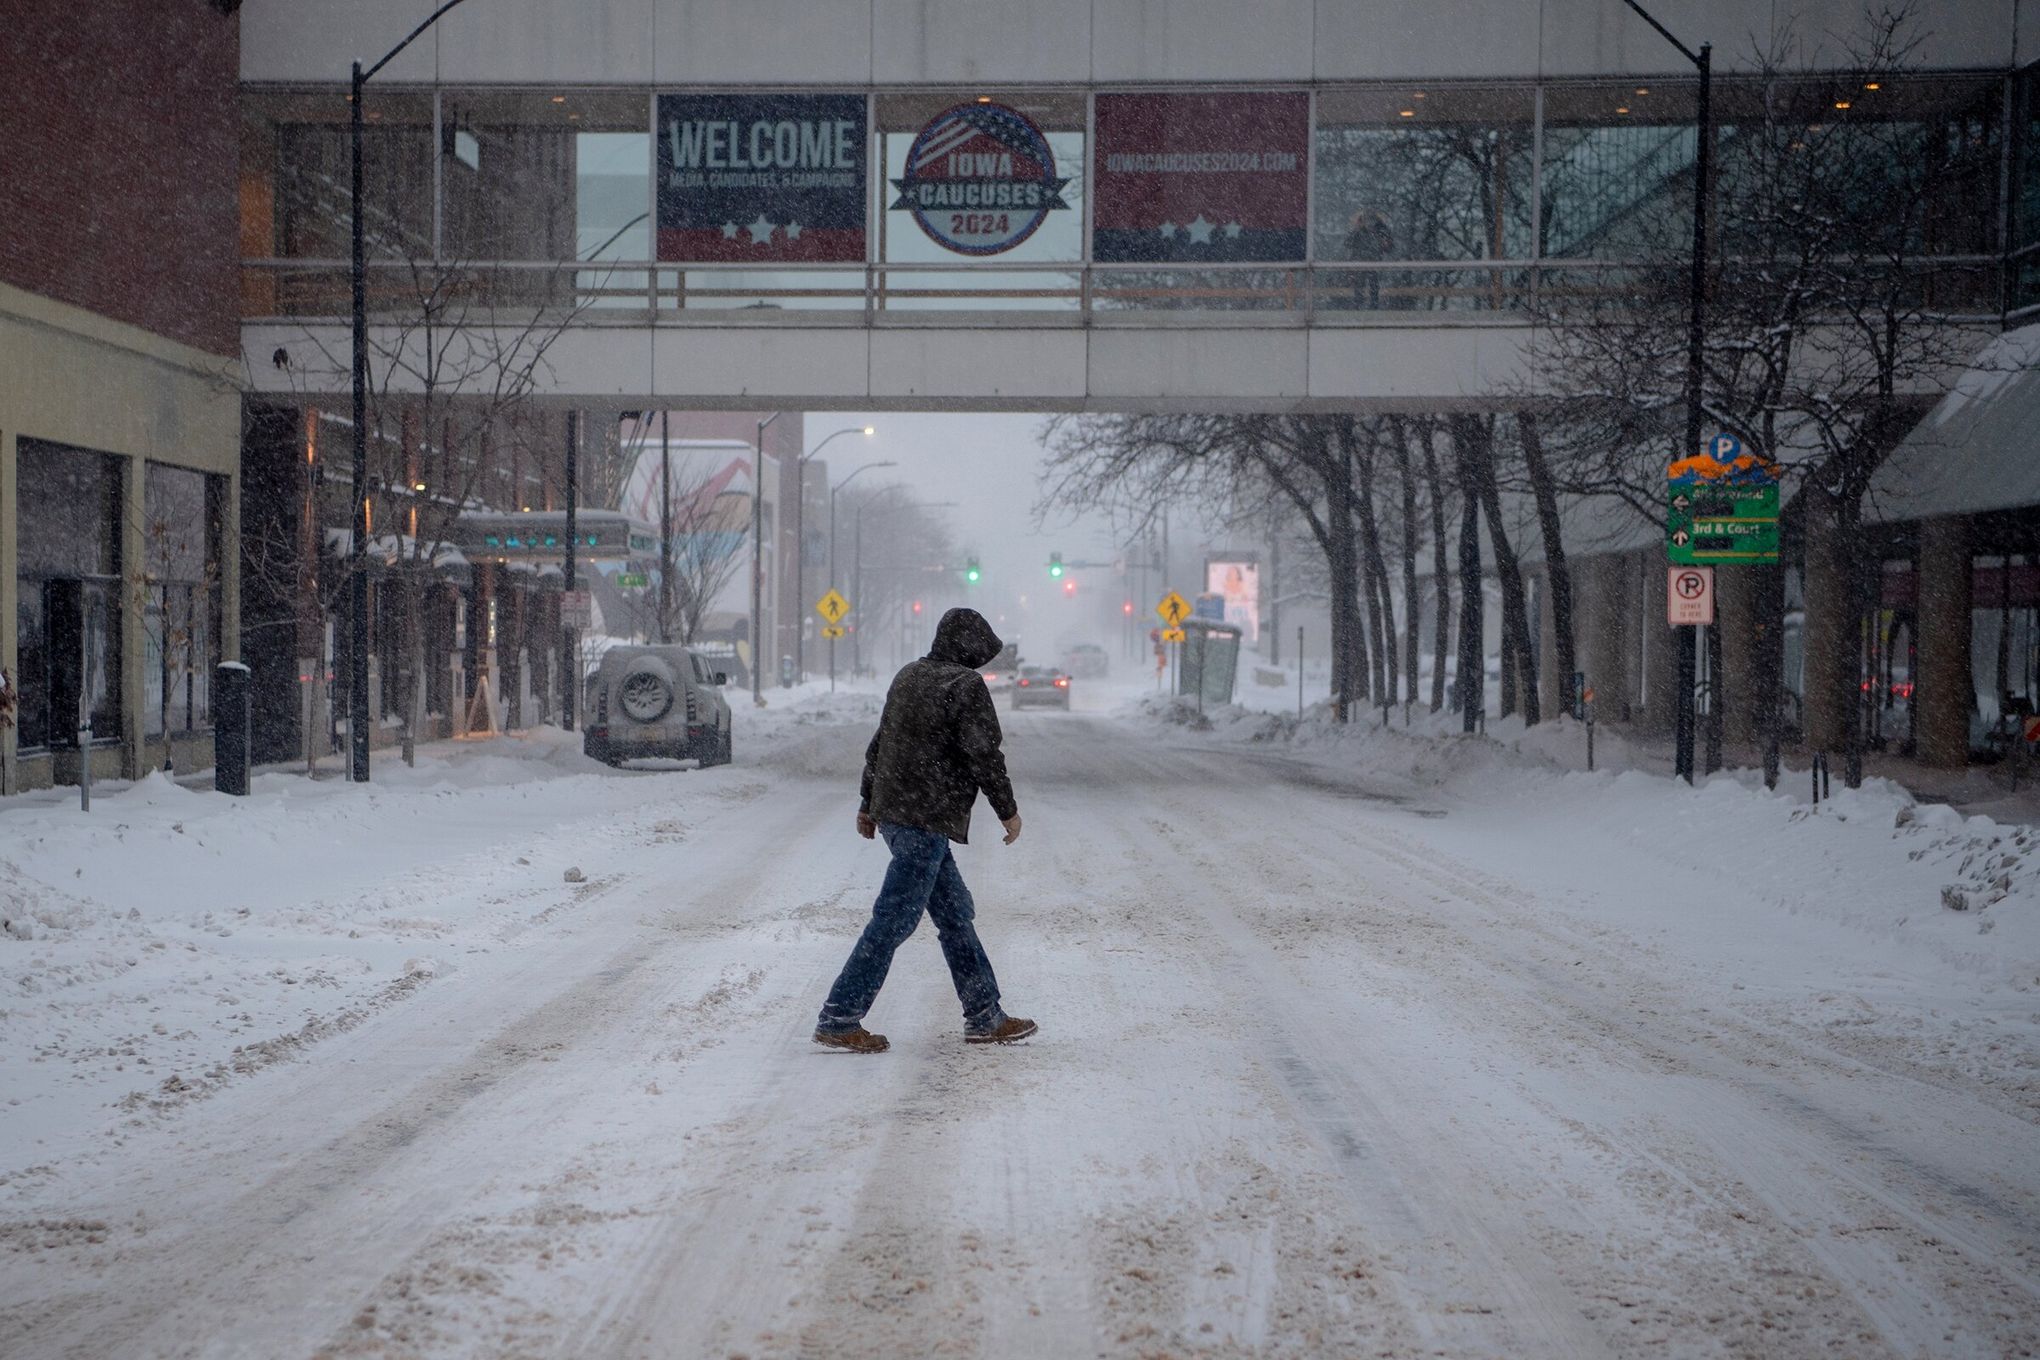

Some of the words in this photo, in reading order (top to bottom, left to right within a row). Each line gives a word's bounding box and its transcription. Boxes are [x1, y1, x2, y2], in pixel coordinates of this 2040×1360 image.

[669, 120, 856, 168] WELCOME
[947, 153, 1014, 177] IOWA
[1106, 153, 1296, 172] IOWACAUCUSES2024.COM
[919, 183, 1040, 206] CAUCUSES
[950, 214, 1010, 235] 2024
[1717, 438, 1733, 459] P
[1693, 523, 1712, 534] 3rd
[1715, 523, 1724, 534] &
[1727, 523, 1760, 535] Court
